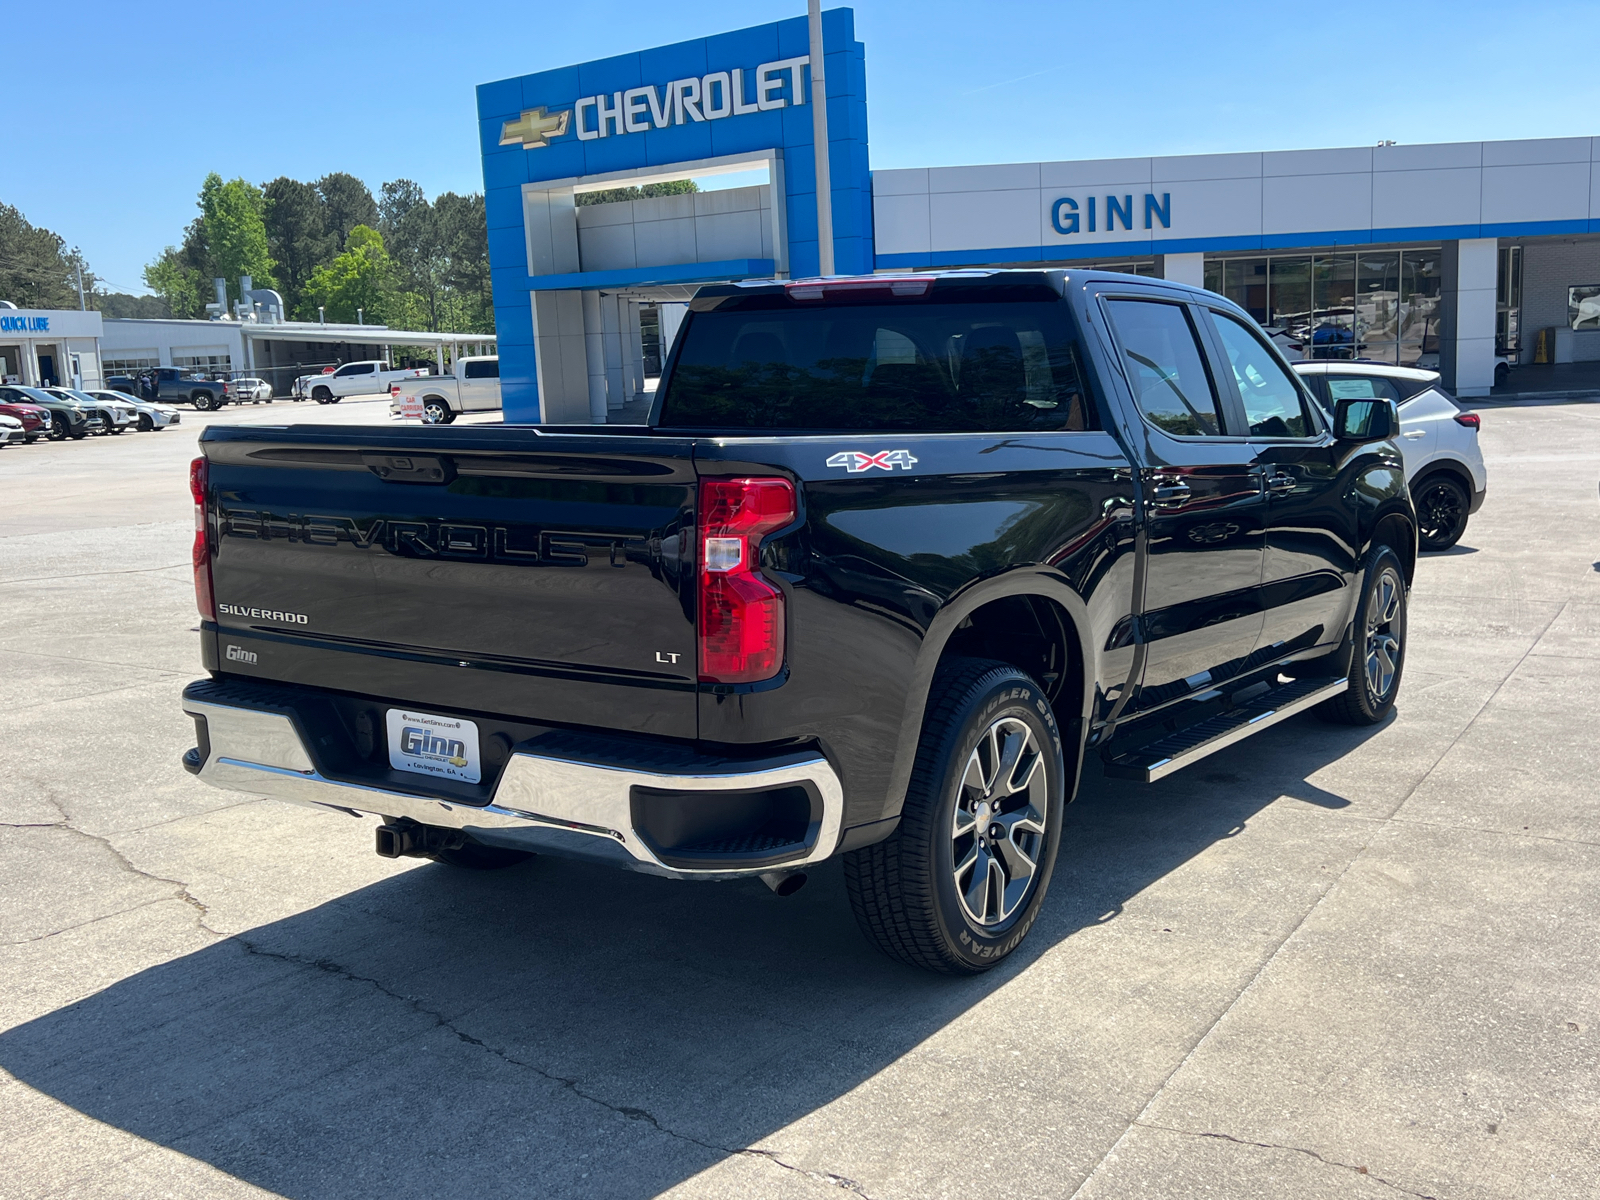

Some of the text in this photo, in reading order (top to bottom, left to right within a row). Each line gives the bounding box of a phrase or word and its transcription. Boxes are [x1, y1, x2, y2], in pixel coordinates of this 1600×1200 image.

[574, 55, 810, 141] CHEVROLET
[1052, 192, 1171, 235] GINN
[0, 316, 50, 331] QUICK LUBE
[226, 508, 646, 568] CHEVROLET
[219, 603, 309, 625] SILVERADO
[226, 644, 258, 664] Ginn
[655, 651, 682, 664] LT
[400, 726, 465, 759] Ginn
